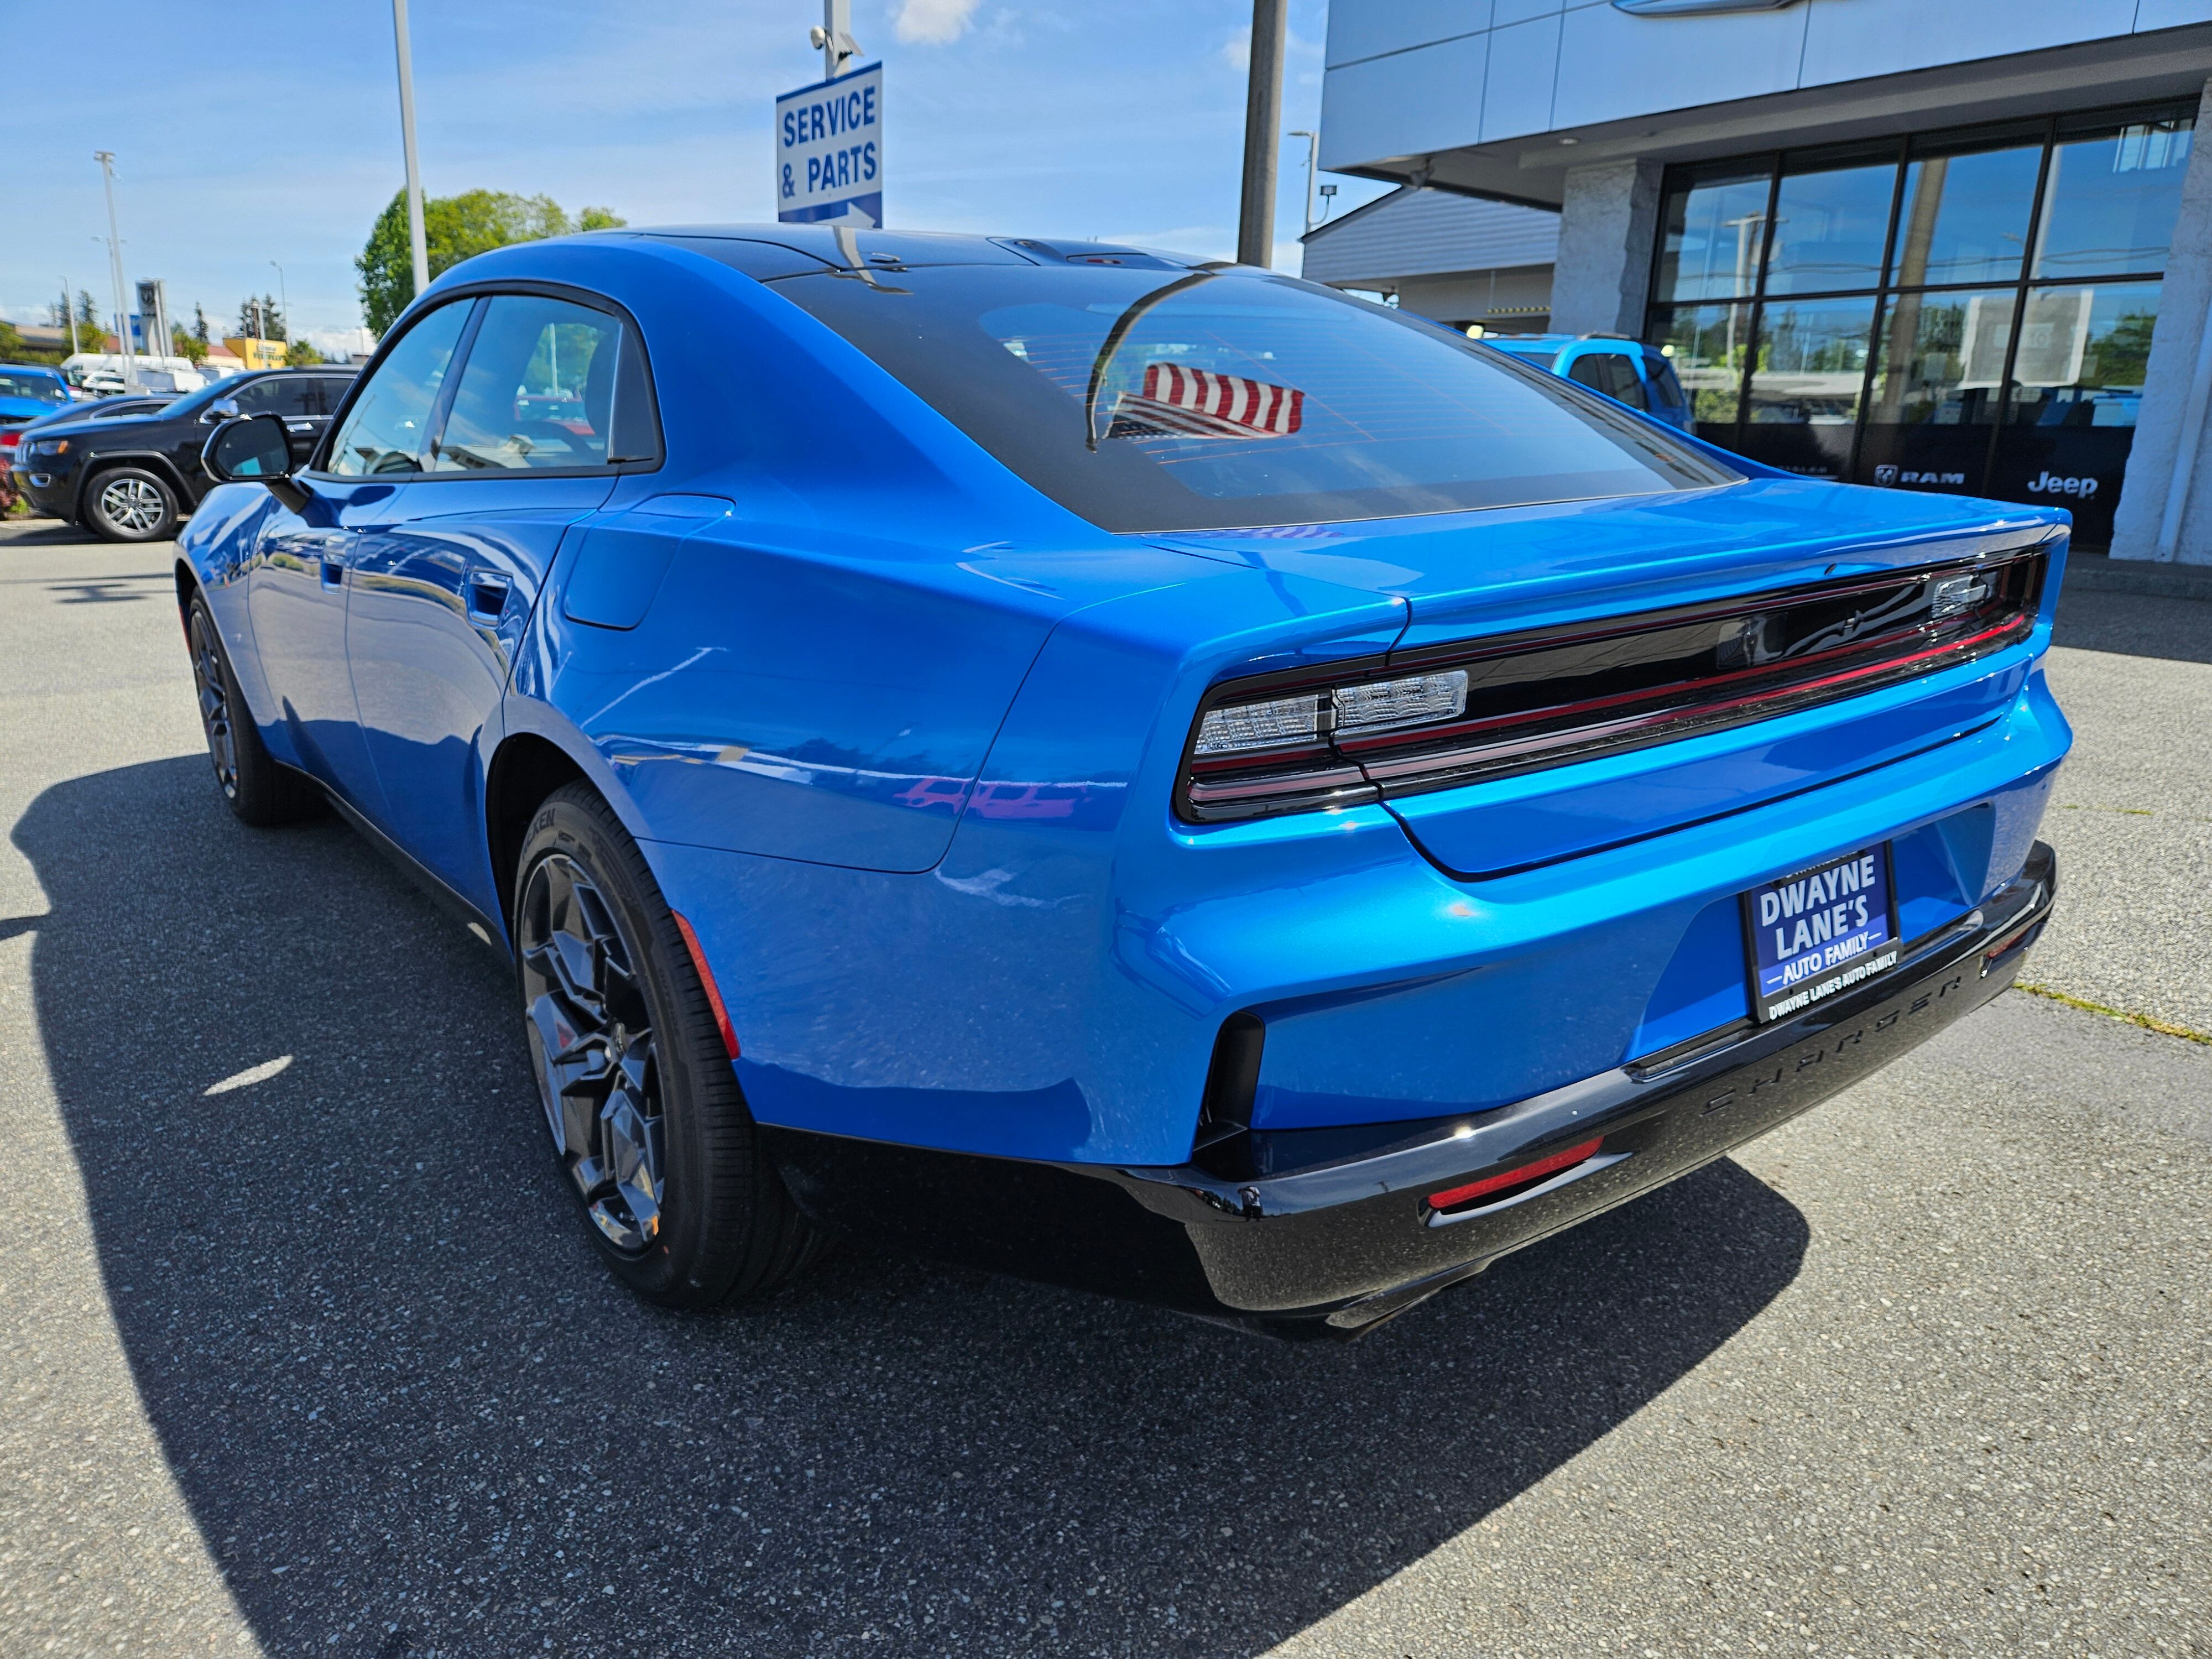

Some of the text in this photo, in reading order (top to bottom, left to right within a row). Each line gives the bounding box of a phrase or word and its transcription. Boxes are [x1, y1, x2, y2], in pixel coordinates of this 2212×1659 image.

[783, 84, 876, 148] SERVICE
[782, 141, 877, 199] & PARTS
[1900, 472, 1965, 484] RAM
[2027, 471, 2098, 499] Jeep
[1760, 854, 1875, 927] DWAYNE
[1775, 895, 1869, 961] LANE'S
[1782, 931, 1869, 985] AUTO FAMILY
[1768, 991, 1810, 1021] DWAYNE
[1842, 966, 1866, 988] AUTO
[1865, 951, 1897, 976] FAMILY
